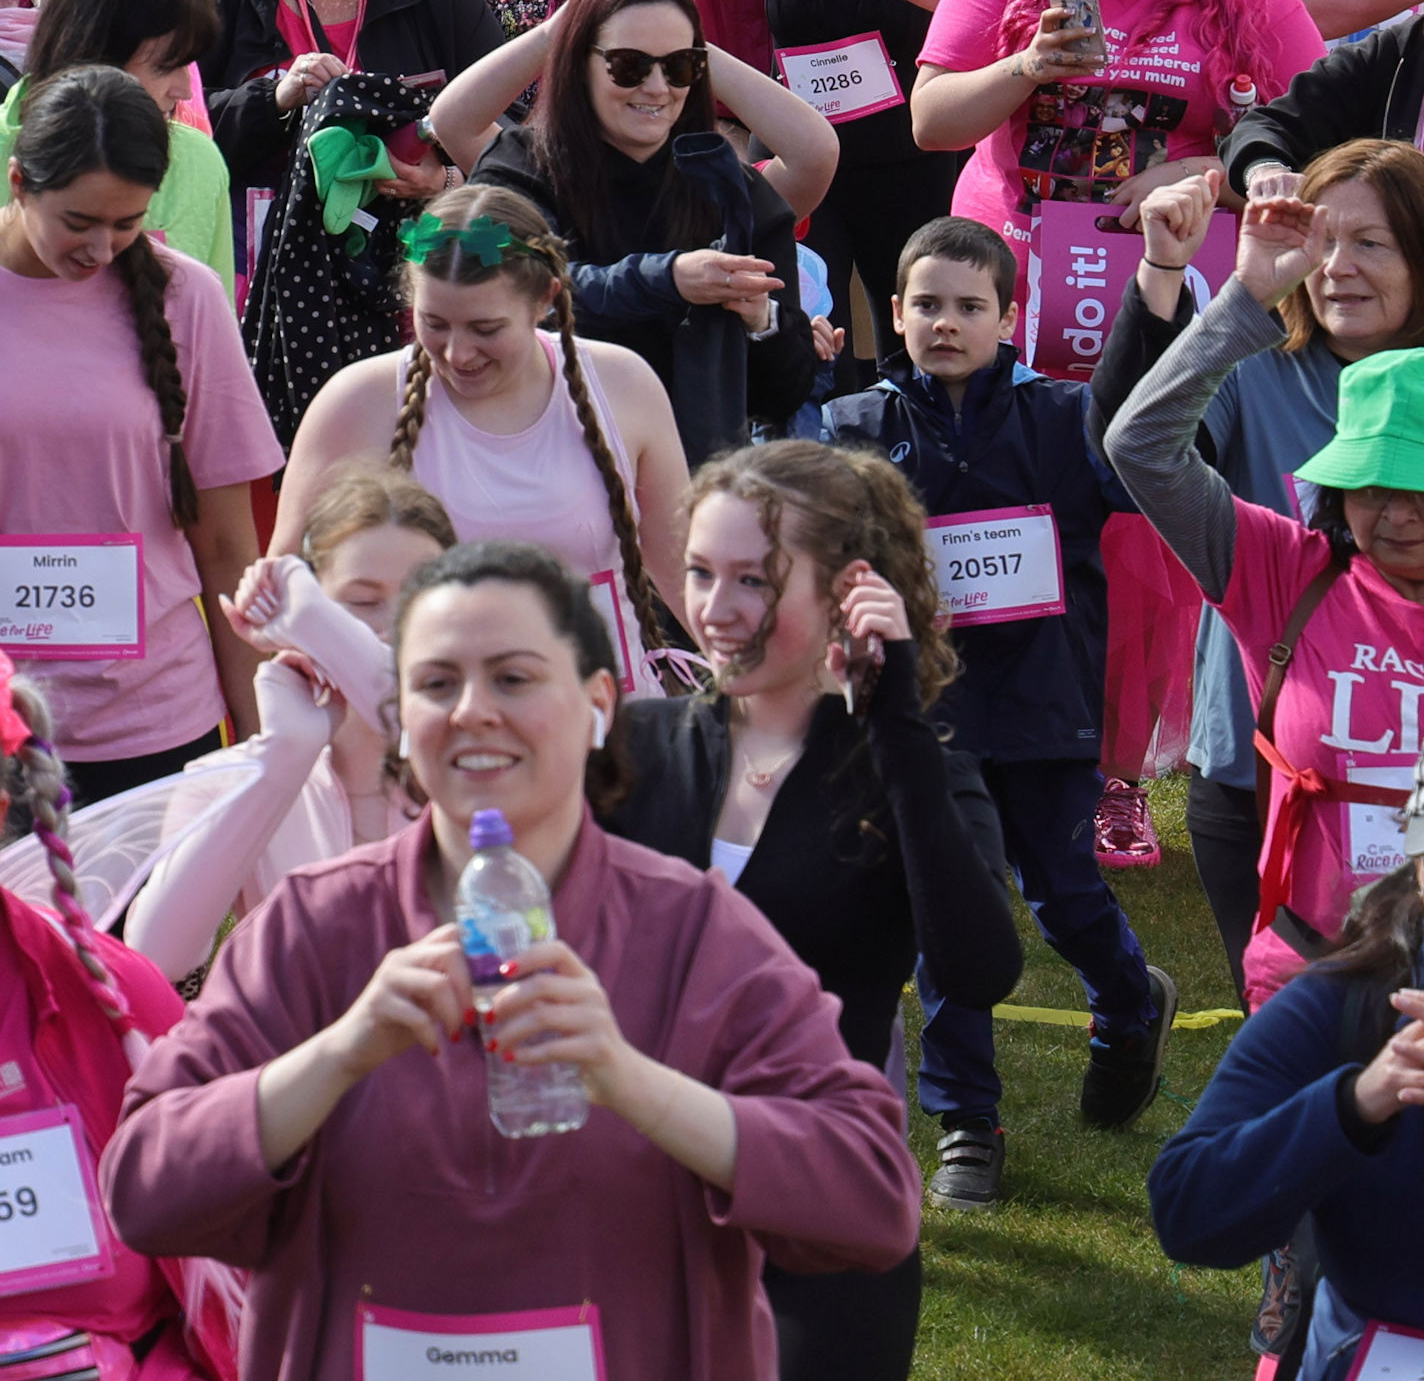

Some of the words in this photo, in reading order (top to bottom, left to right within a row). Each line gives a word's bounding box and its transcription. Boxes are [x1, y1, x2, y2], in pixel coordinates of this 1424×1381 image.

[810, 54, 849, 68] Cinnelle
[810, 69, 863, 95] 21286
[1110, 69, 1142, 85] you
[1145, 72, 1186, 88] mum
[1065, 245, 1107, 289] it!
[1063, 297, 1106, 356] do
[941, 530, 981, 546] Finn's
[984, 527, 1022, 541] team
[32, 554, 77, 568] Mirrin
[949, 552, 1023, 581] 20517
[14, 584, 95, 608] 21736
[964, 590, 989, 606] Life
[9, 625, 25, 635] for
[25, 622, 53, 639] Life
[1356, 853, 1390, 870] Race
[425, 1345, 519, 1367] Gemma
